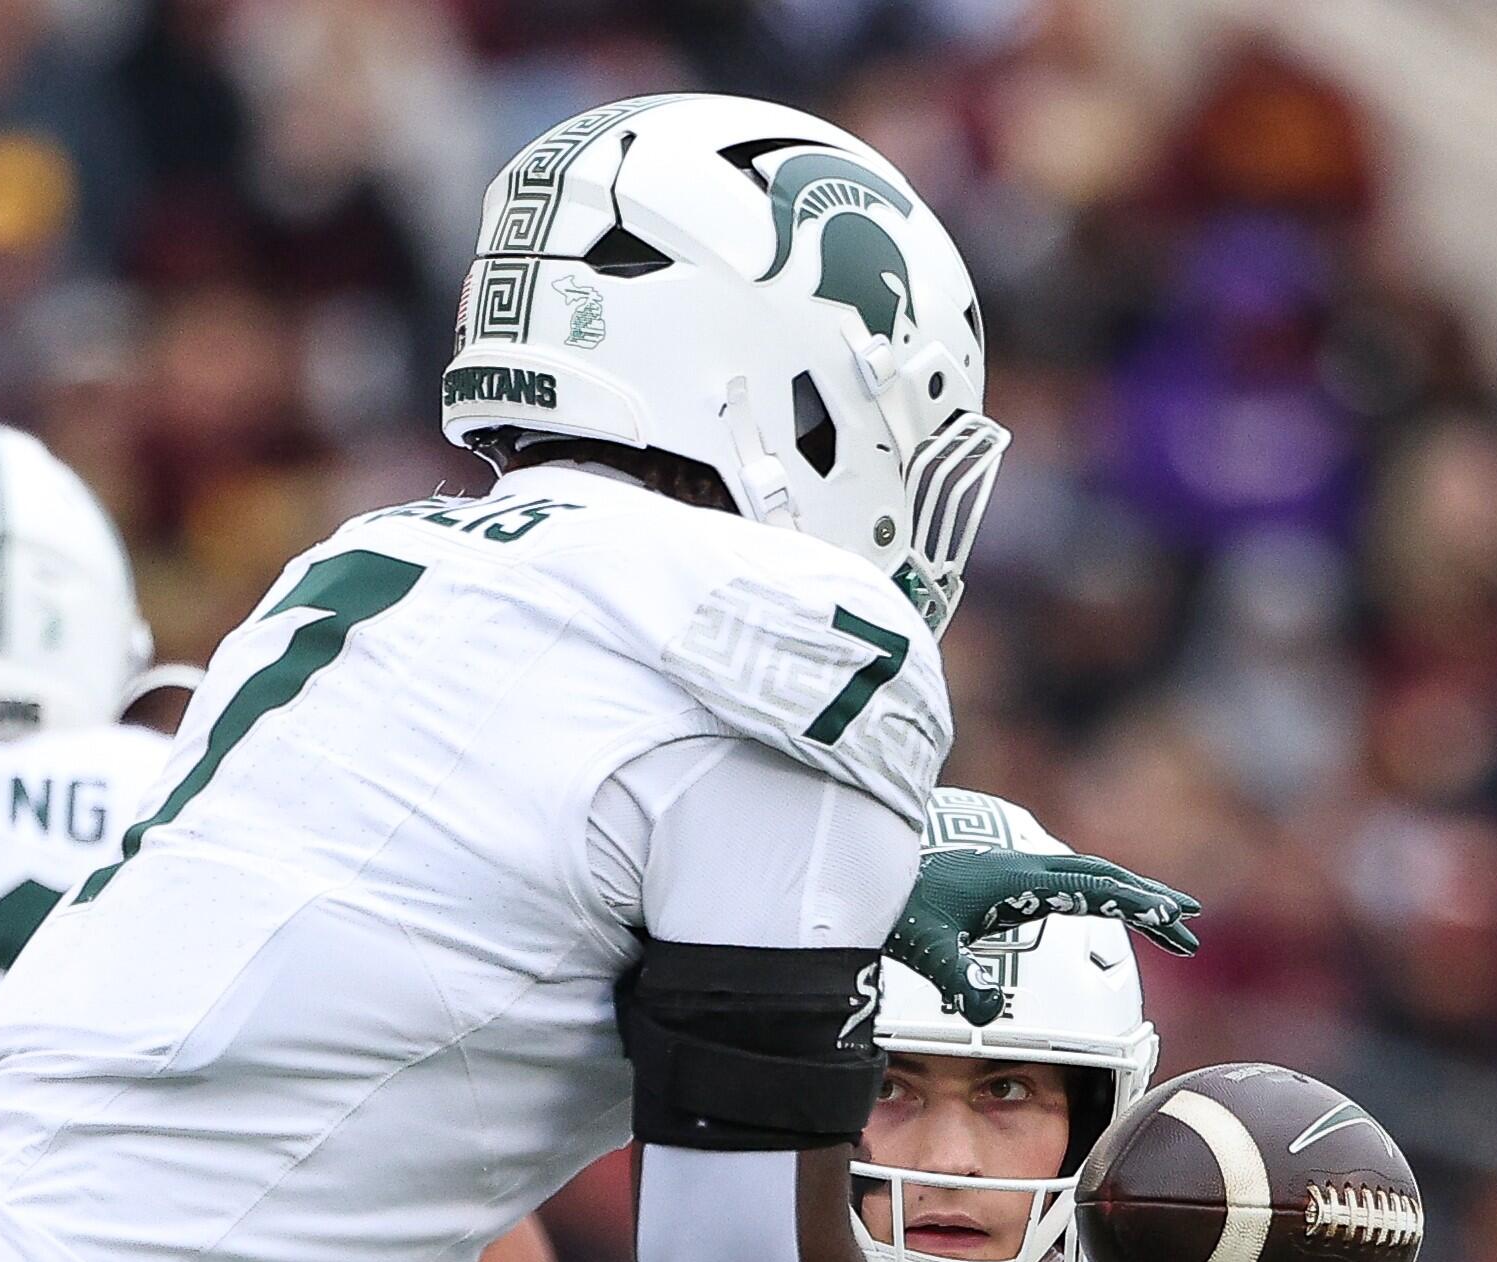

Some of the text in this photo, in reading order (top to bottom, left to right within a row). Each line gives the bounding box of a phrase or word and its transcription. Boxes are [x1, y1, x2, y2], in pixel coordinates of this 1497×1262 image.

[443, 365, 558, 410] SPARTANS
[67, 549, 427, 906] 7
[802, 603, 911, 744] 7
